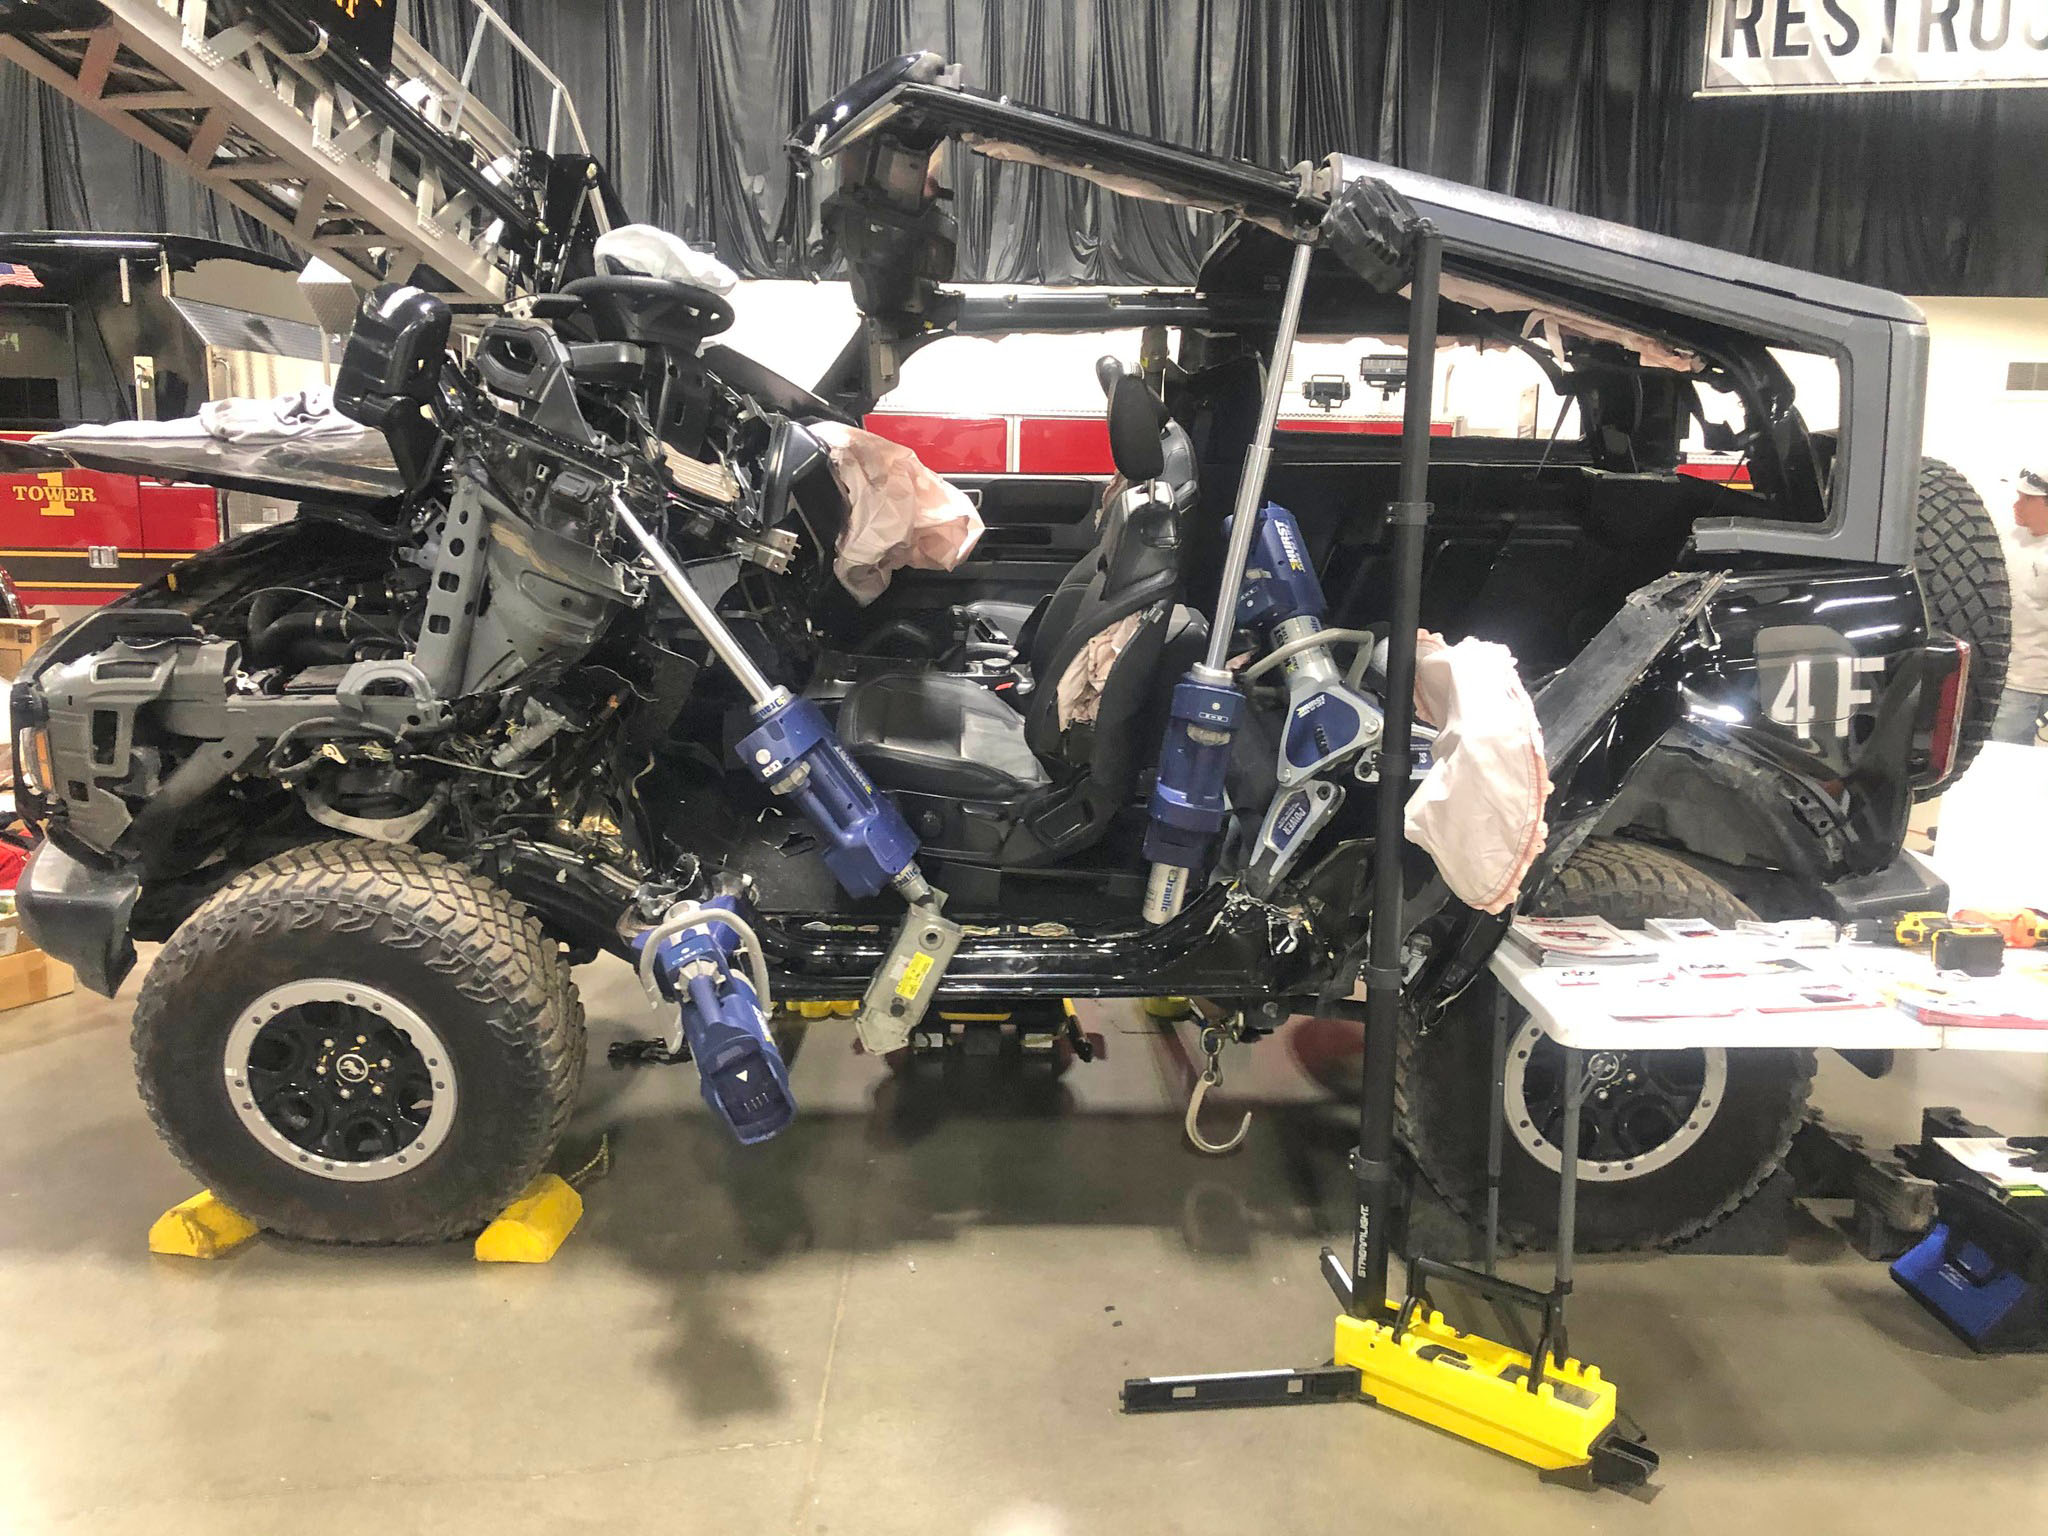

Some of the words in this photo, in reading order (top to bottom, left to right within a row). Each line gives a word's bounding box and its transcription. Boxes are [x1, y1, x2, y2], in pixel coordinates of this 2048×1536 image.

[12, 486, 97, 502] TOWER
[37, 472, 75, 516] 1
[1273, 518, 1298, 564] HURST
[1283, 807, 1306, 835] POWER
